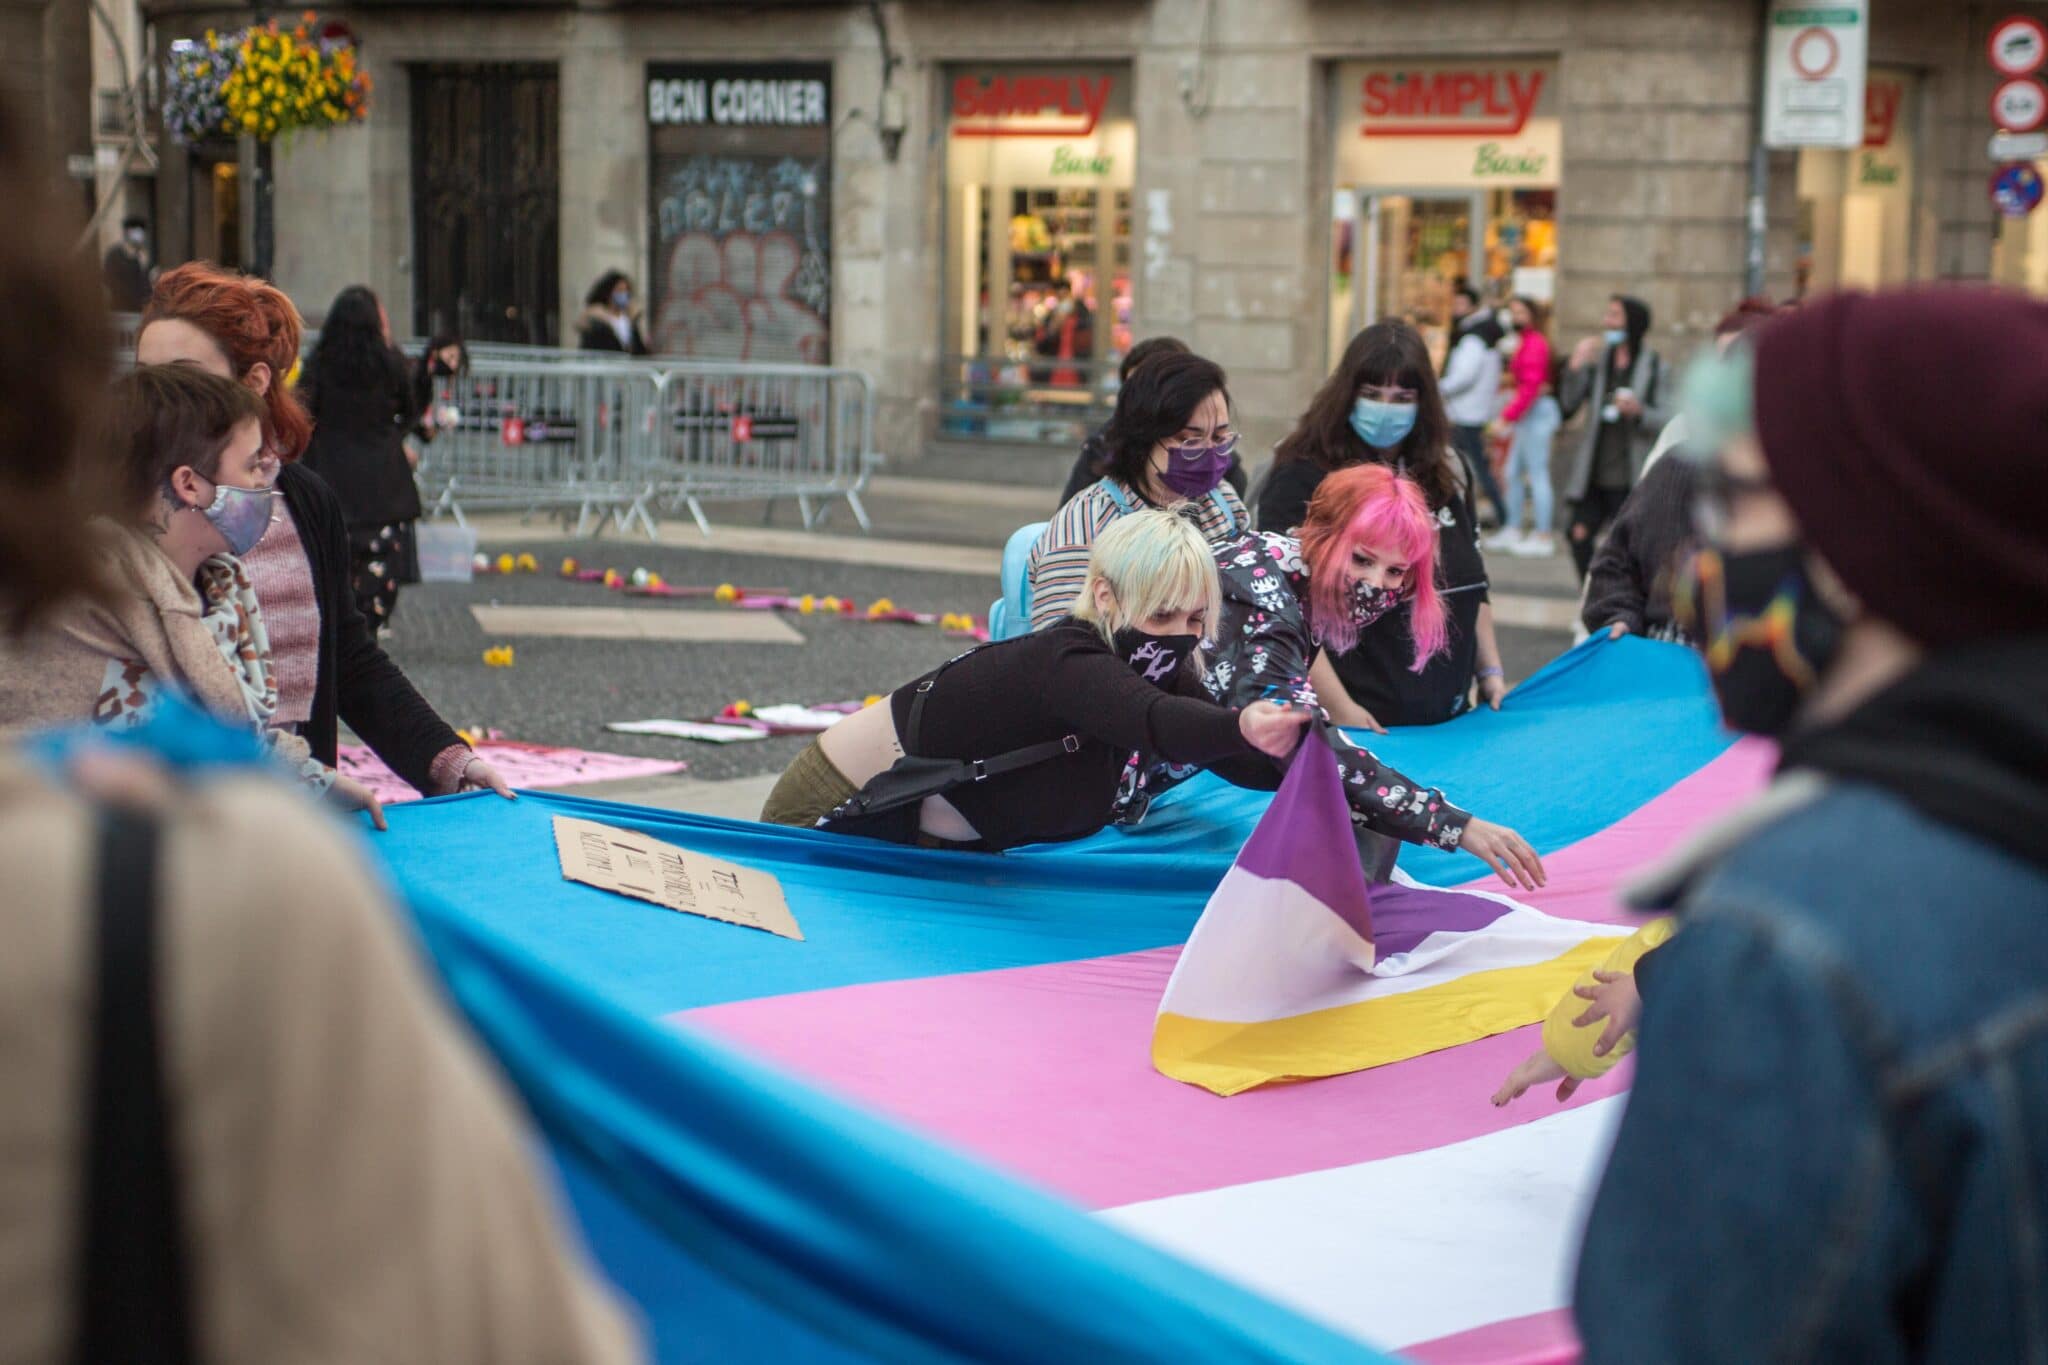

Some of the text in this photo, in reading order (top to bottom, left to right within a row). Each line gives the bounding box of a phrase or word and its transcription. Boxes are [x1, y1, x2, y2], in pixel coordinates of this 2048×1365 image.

[650, 80, 825, 123] BCN CORNER
[1474, 143, 1546, 176] Basic
